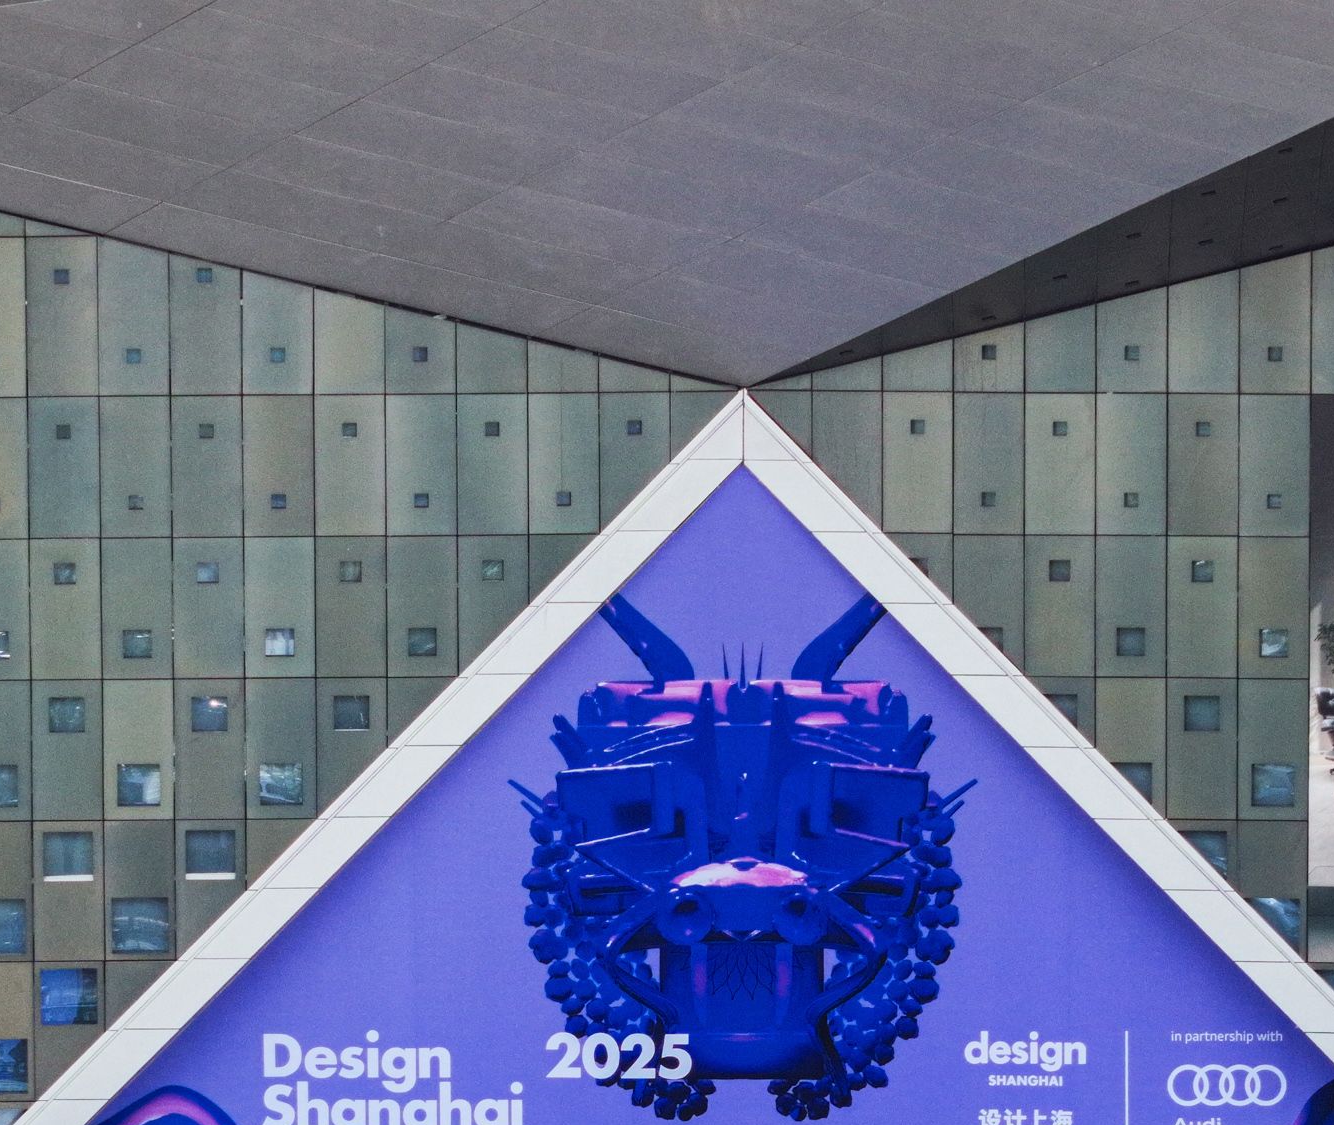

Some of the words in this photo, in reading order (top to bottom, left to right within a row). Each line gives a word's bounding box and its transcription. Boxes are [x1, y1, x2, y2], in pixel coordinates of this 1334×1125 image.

[545, 1032, 693, 1080] 2025
[964, 1030, 1087, 1072] design
[1170, 1030, 1183, 1042] in
[1185, 1030, 1254, 1044] partnership
[1256, 1030, 1283, 1042] with
[262, 1029, 451, 1093] Design
[988, 1075, 1064, 1087] SHANGHAI
